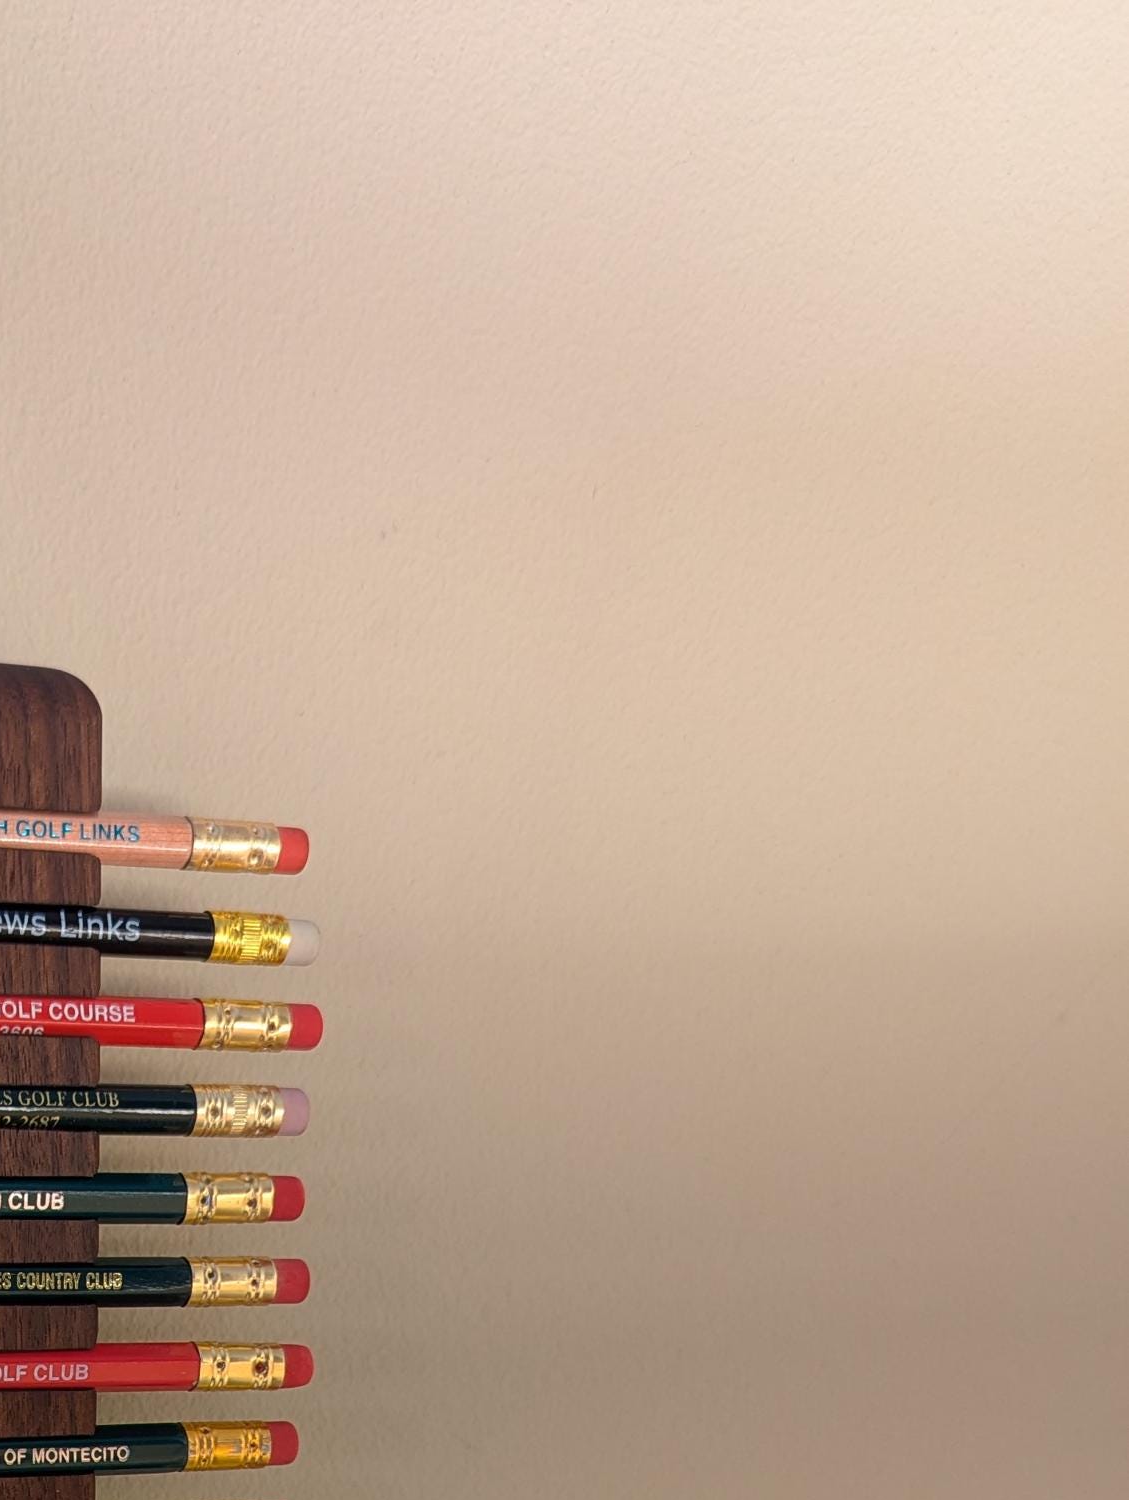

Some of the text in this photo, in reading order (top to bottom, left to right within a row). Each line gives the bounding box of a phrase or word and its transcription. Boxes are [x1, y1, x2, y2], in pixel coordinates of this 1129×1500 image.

[16, 820, 73, 839] GOLF
[80, 823, 140, 842] LINKS
[60, 909, 141, 942] Links
[49, 1002, 136, 1023] COURSE
[18, 1090, 67, 1107] GOLF
[72, 1091, 120, 1108] CLUB
[8, 1190, 65, 1211] CLUB
[17, 1271, 81, 1290] COUNTRY
[86, 1271, 123, 1290] CLUB
[33, 1363, 89, 1382] CLUB
[4, 1448, 27, 1466] OF
[32, 1445, 130, 1464] MONTECITO
